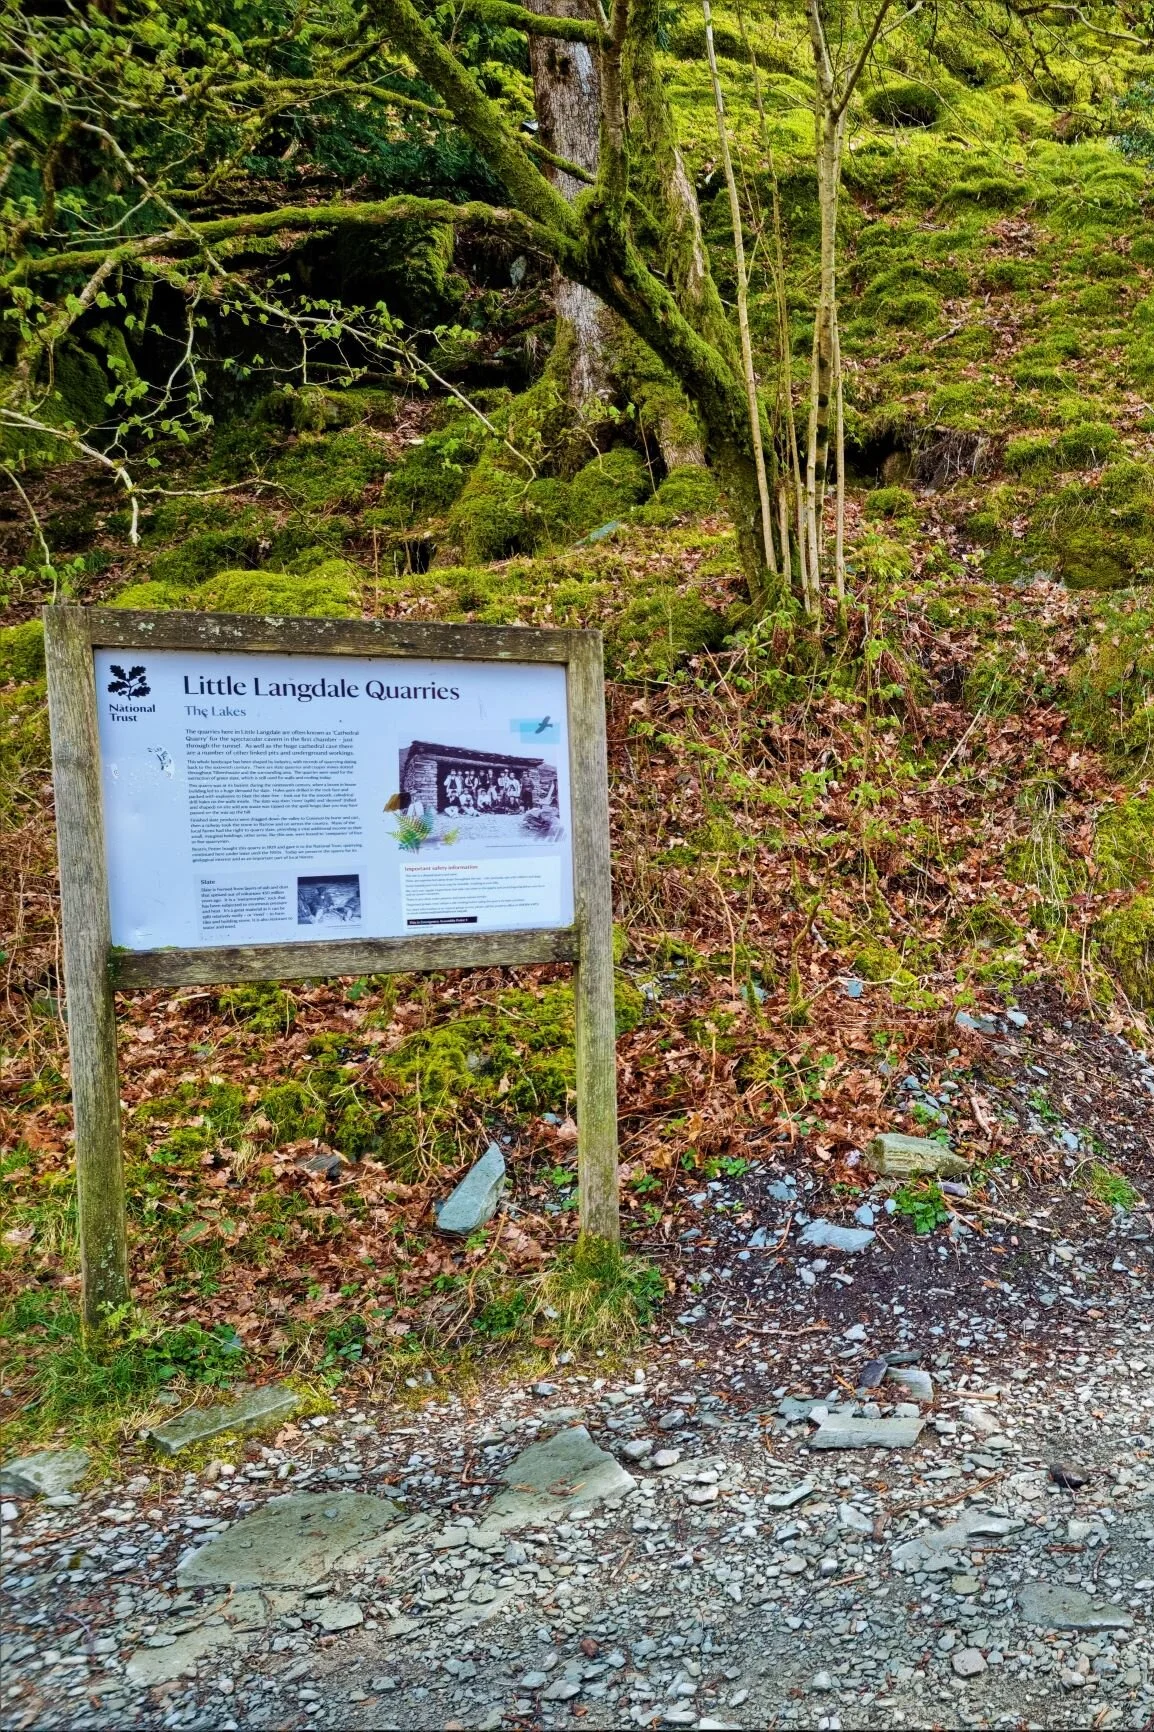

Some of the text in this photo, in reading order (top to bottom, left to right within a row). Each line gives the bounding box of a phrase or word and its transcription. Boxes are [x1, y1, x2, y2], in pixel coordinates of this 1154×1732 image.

[184, 675, 460, 702] Little Langdale Quarries
[109, 704, 156, 713] National
[184, 705, 246, 717] The Lakes
[109, 713, 137, 722] Trust
